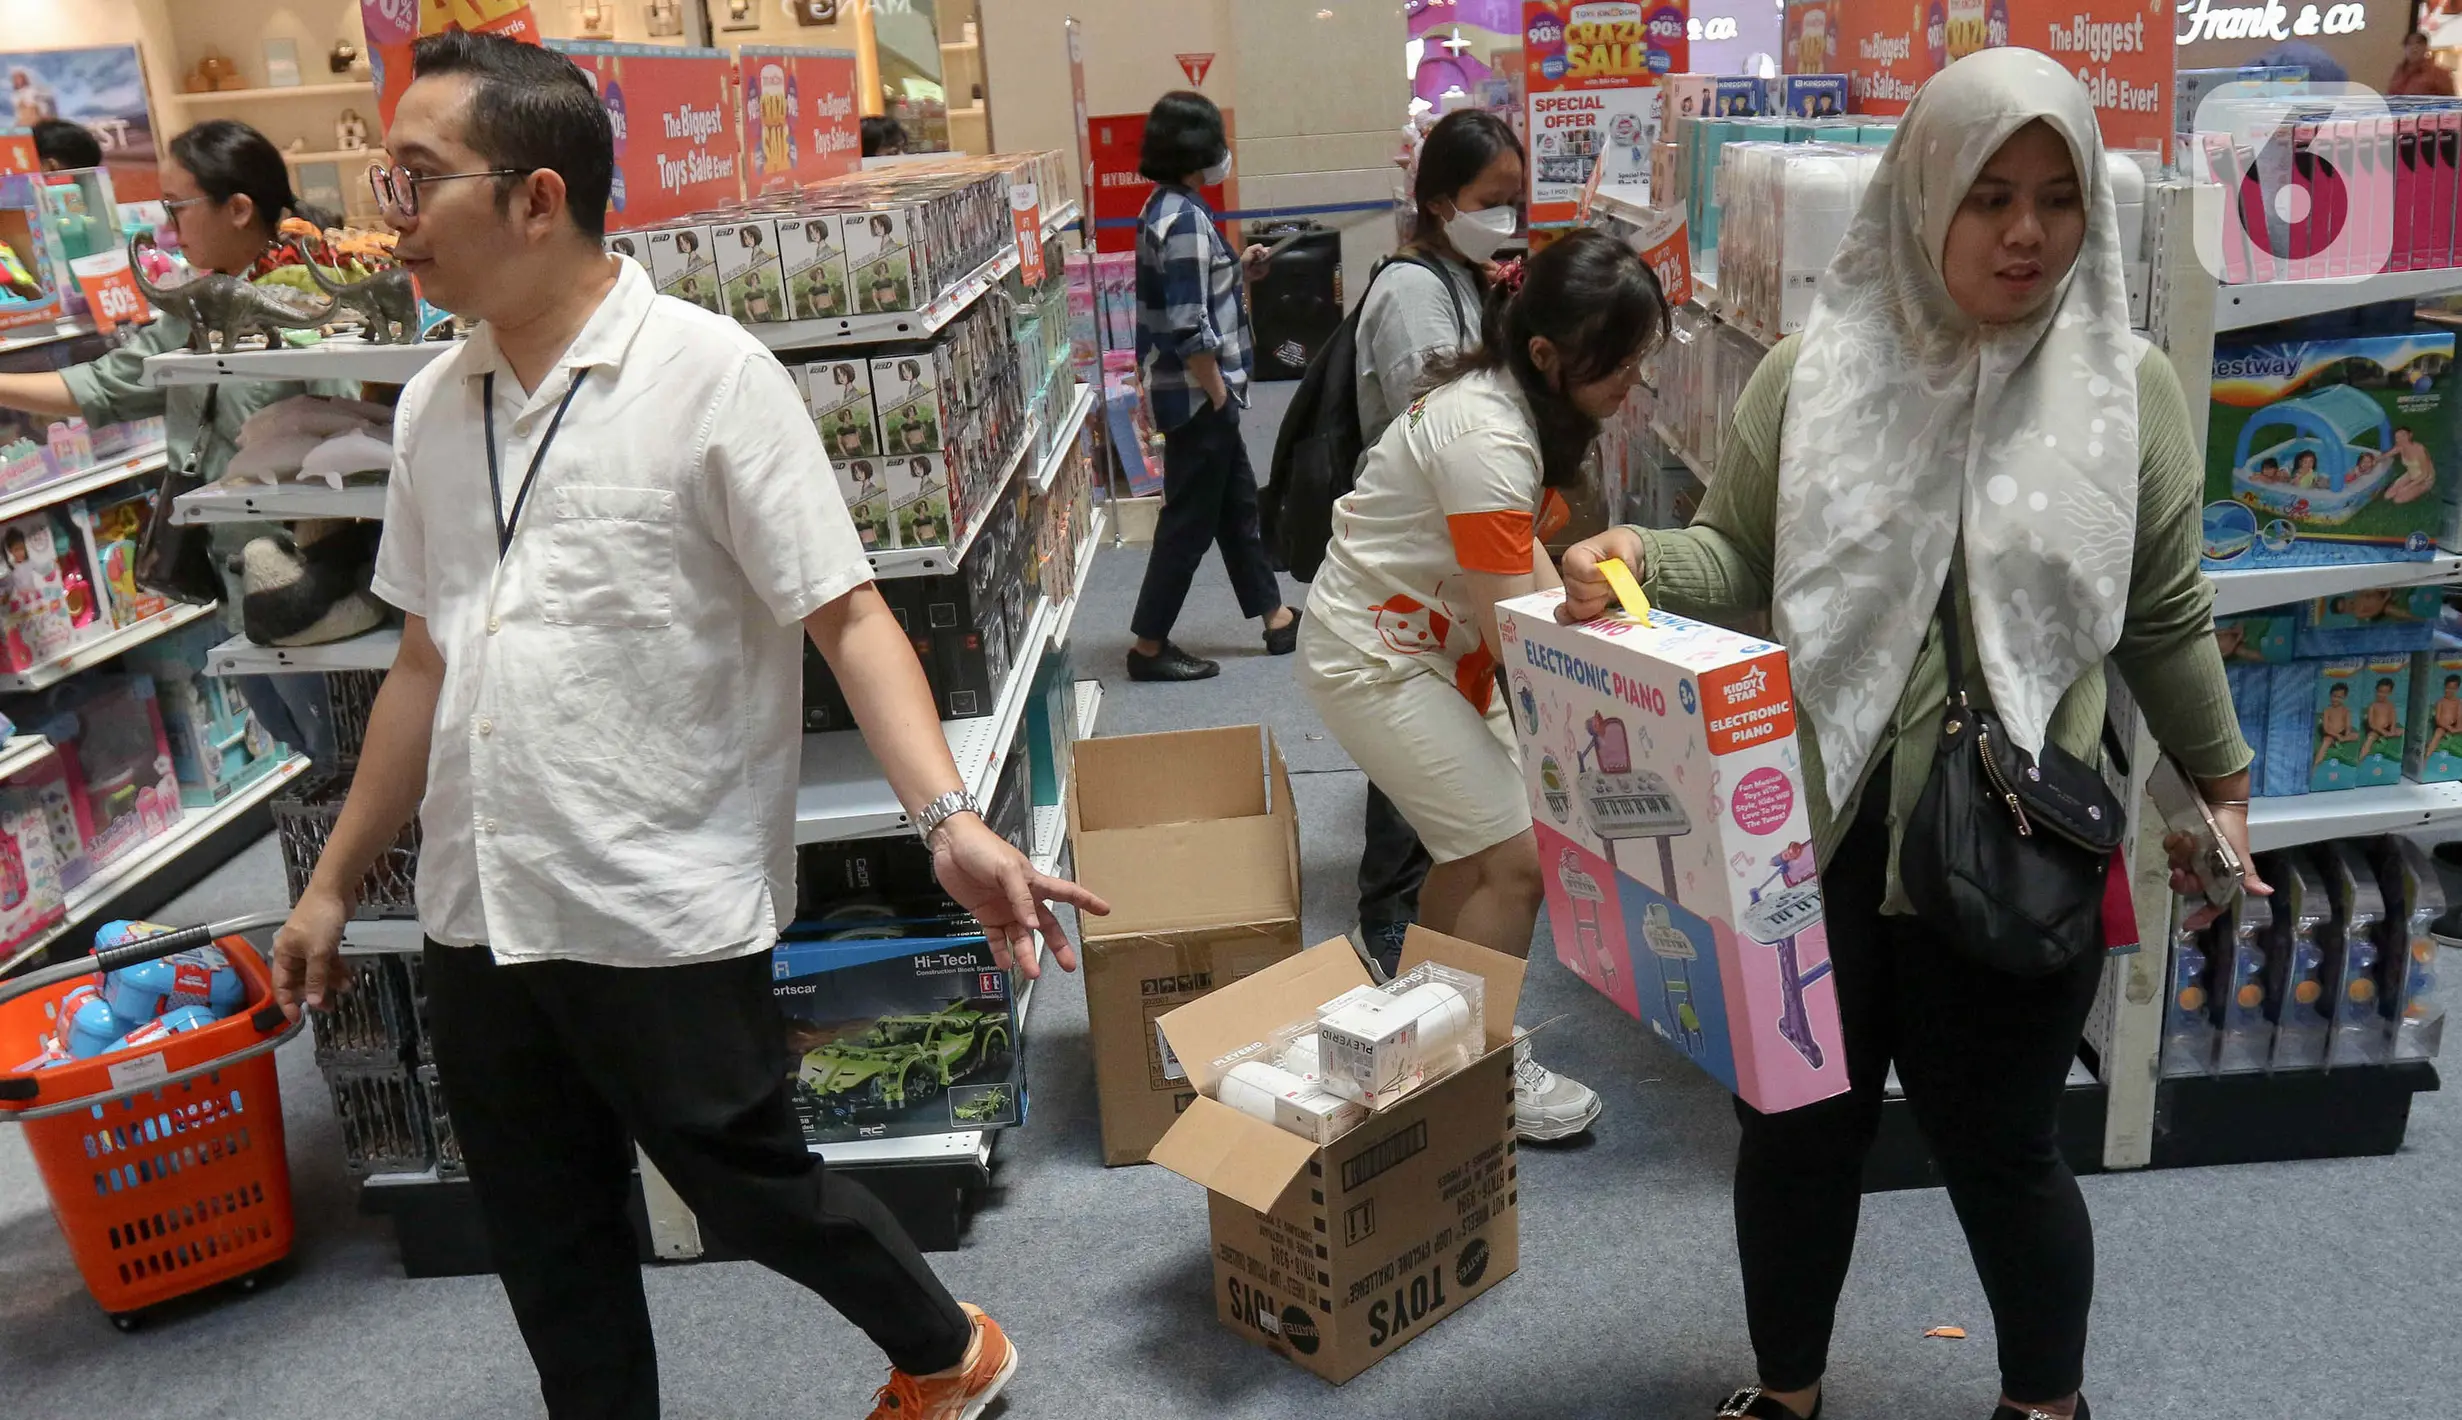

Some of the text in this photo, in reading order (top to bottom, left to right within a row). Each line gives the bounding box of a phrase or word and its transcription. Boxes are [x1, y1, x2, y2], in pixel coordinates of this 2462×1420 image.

[1563, 20, 1648, 46] CRAZY
[2176, 0, 2290, 45] Frank
[2293, 2, 2320, 36] &
[1860, 38, 1872, 59] The
[1872, 31, 1910, 67] Biggest
[2050, 12, 2145, 63] The Biggest
[1566, 43, 1649, 77] SALE
[1803, 79, 1840, 89] keeppley
[1851, 69, 1872, 104] Toys
[1872, 70, 1894, 98] Sale
[2077, 66, 2118, 109] Sale
[2120, 80, 2159, 113] Ever!
[1535, 96, 1605, 112] SPECIAL
[663, 103, 723, 144] The Biggest
[1544, 112, 1596, 128] OFFER
[657, 148, 733, 195] Toys Sale Ever!
[1101, 172, 1155, 187] HYDRA
[1672, 278, 1684, 291] OFF
[1524, 638, 1667, 717] ELECTRONIC PIANO
[1722, 677, 1757, 696] KIDDY
[1727, 688, 1757, 705] STAR
[1709, 701, 1790, 733] ELECTRONIC
[1732, 722, 1773, 743] PIANO
[1738, 774, 1783, 792] Fun Musical
[1744, 784, 1780, 800] Toys With
[1735, 790, 1790, 813] Style, Kids Will
[1742, 802, 1787, 821] Love To Play
[1745, 812, 1786, 829] The Tunes!
[916, 967, 957, 976] Construction
[957, 965, 975, 974] Block
[859, 1127, 884, 1136] RC
[1435, 1228, 1453, 1254] LOOP
[1398, 1240, 1431, 1276] CYCLONE
[1350, 1262, 1395, 1304] CHALLENGE
[1228, 1275, 1280, 1340] TOYS
[1368, 1264, 1446, 1348] TOYS
